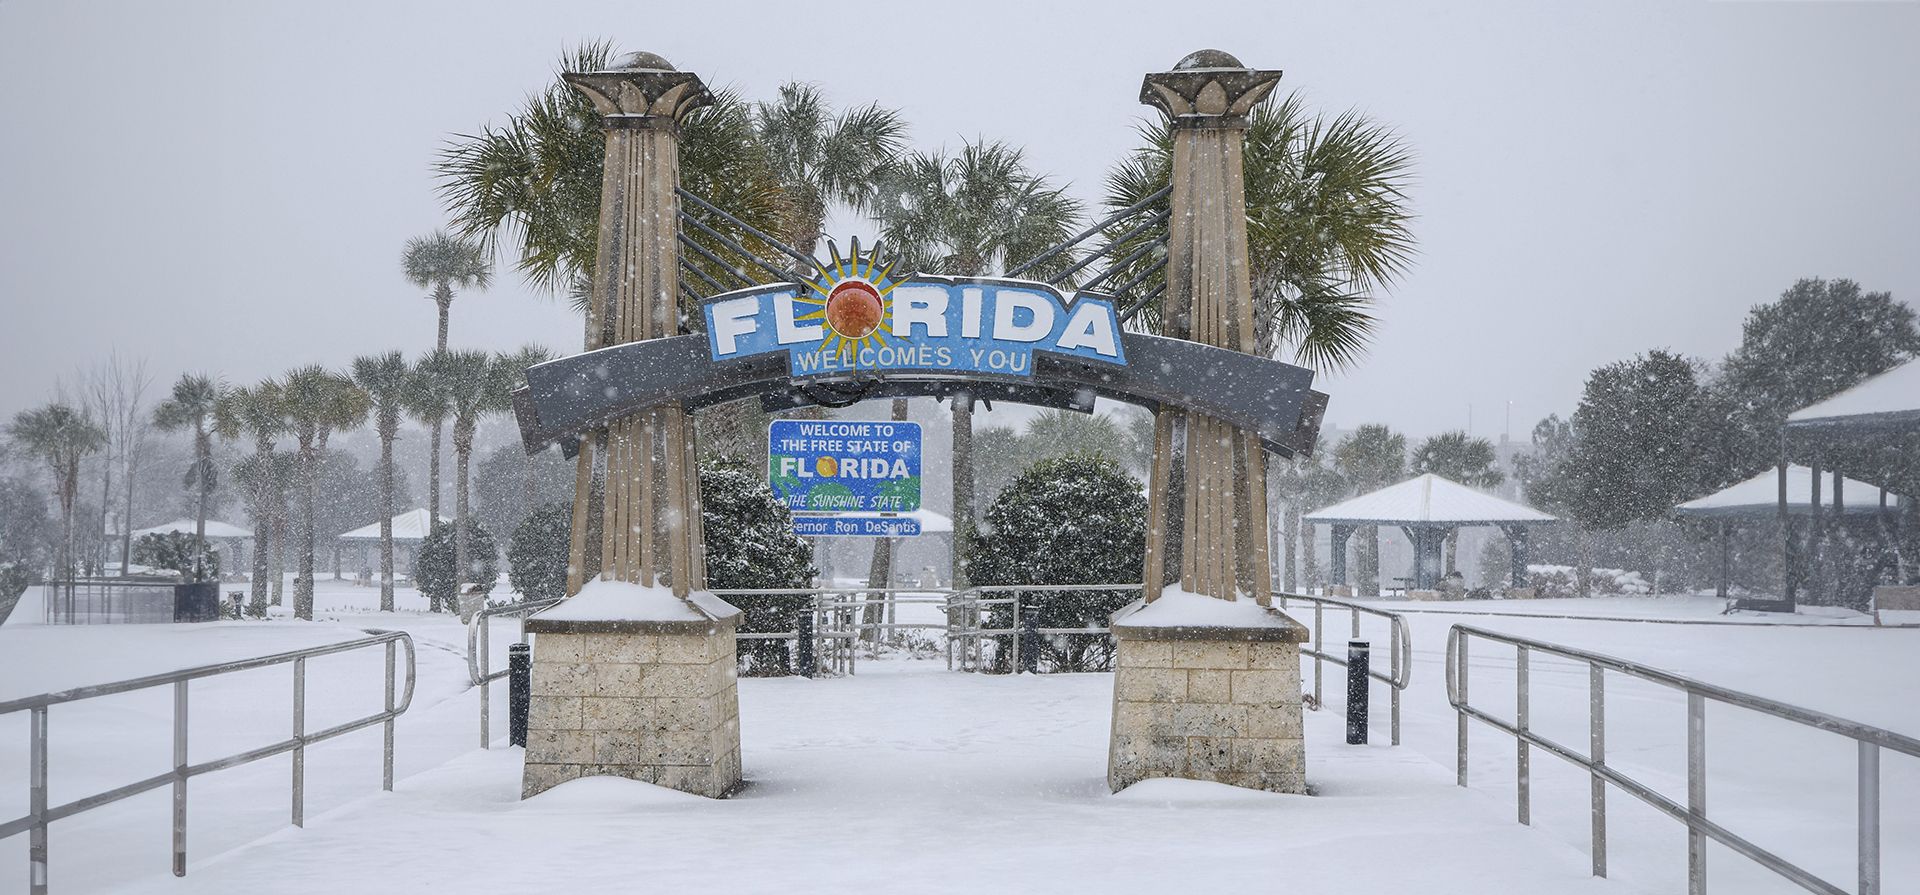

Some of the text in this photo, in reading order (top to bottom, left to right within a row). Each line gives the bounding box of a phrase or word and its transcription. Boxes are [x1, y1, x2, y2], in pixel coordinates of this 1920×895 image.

[711, 279, 1118, 357] FLORIDA
[797, 346, 1028, 372] WELCOMES YOU
[799, 425, 894, 437] WELCOME TO
[781, 439, 911, 452] THE FREE STATE OF
[780, 456, 910, 479] FLORIDA
[787, 494, 902, 508] THE SUNSHINE STATE
[794, 521, 916, 533] ernor Ron DeSantis
